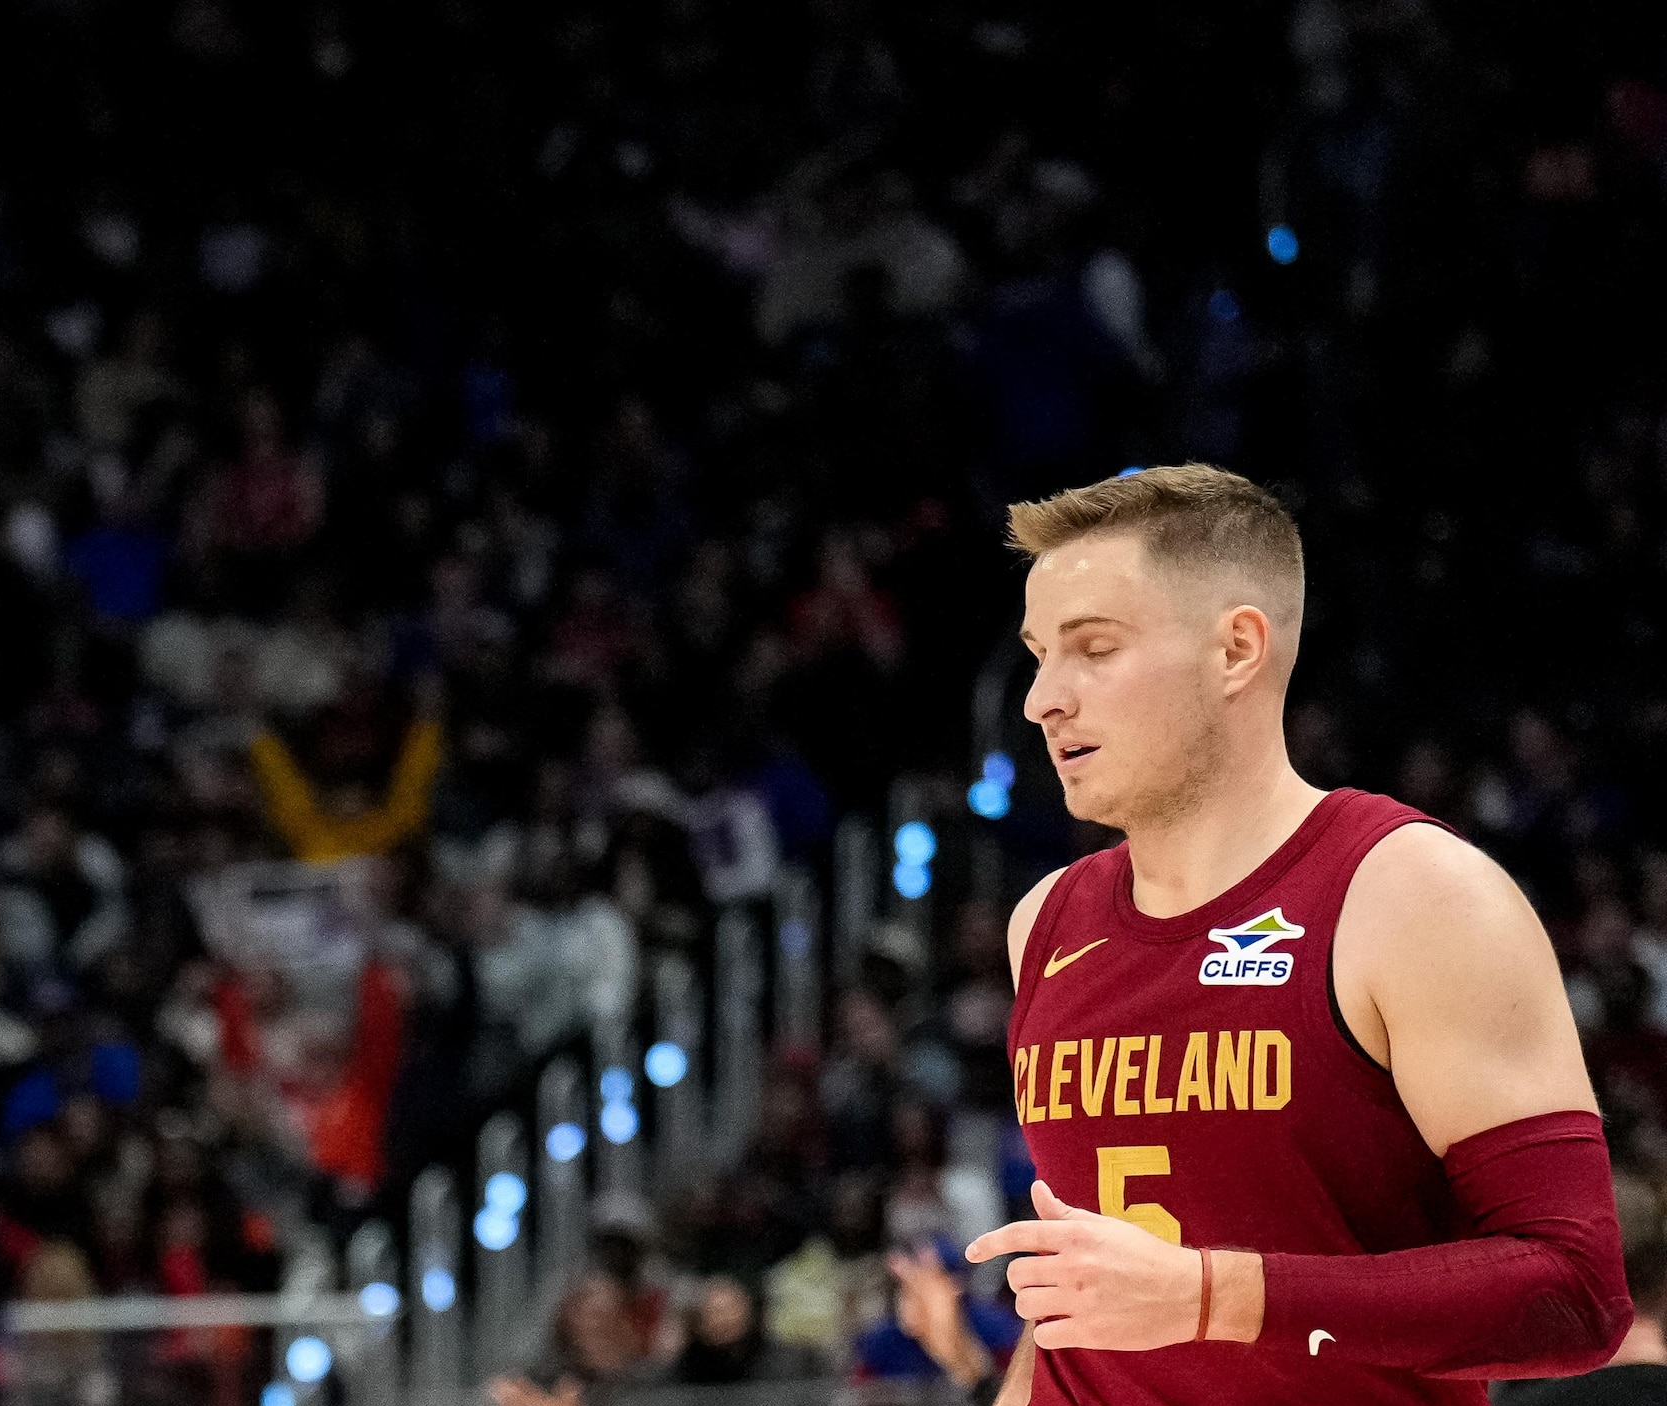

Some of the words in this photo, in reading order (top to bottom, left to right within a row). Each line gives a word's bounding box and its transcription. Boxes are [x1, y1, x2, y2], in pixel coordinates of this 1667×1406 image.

[1203, 960, 1288, 978] CLIFFS
[1014, 1029, 1292, 1126] CLEVELAND
[1096, 1145, 1182, 1247] 5
